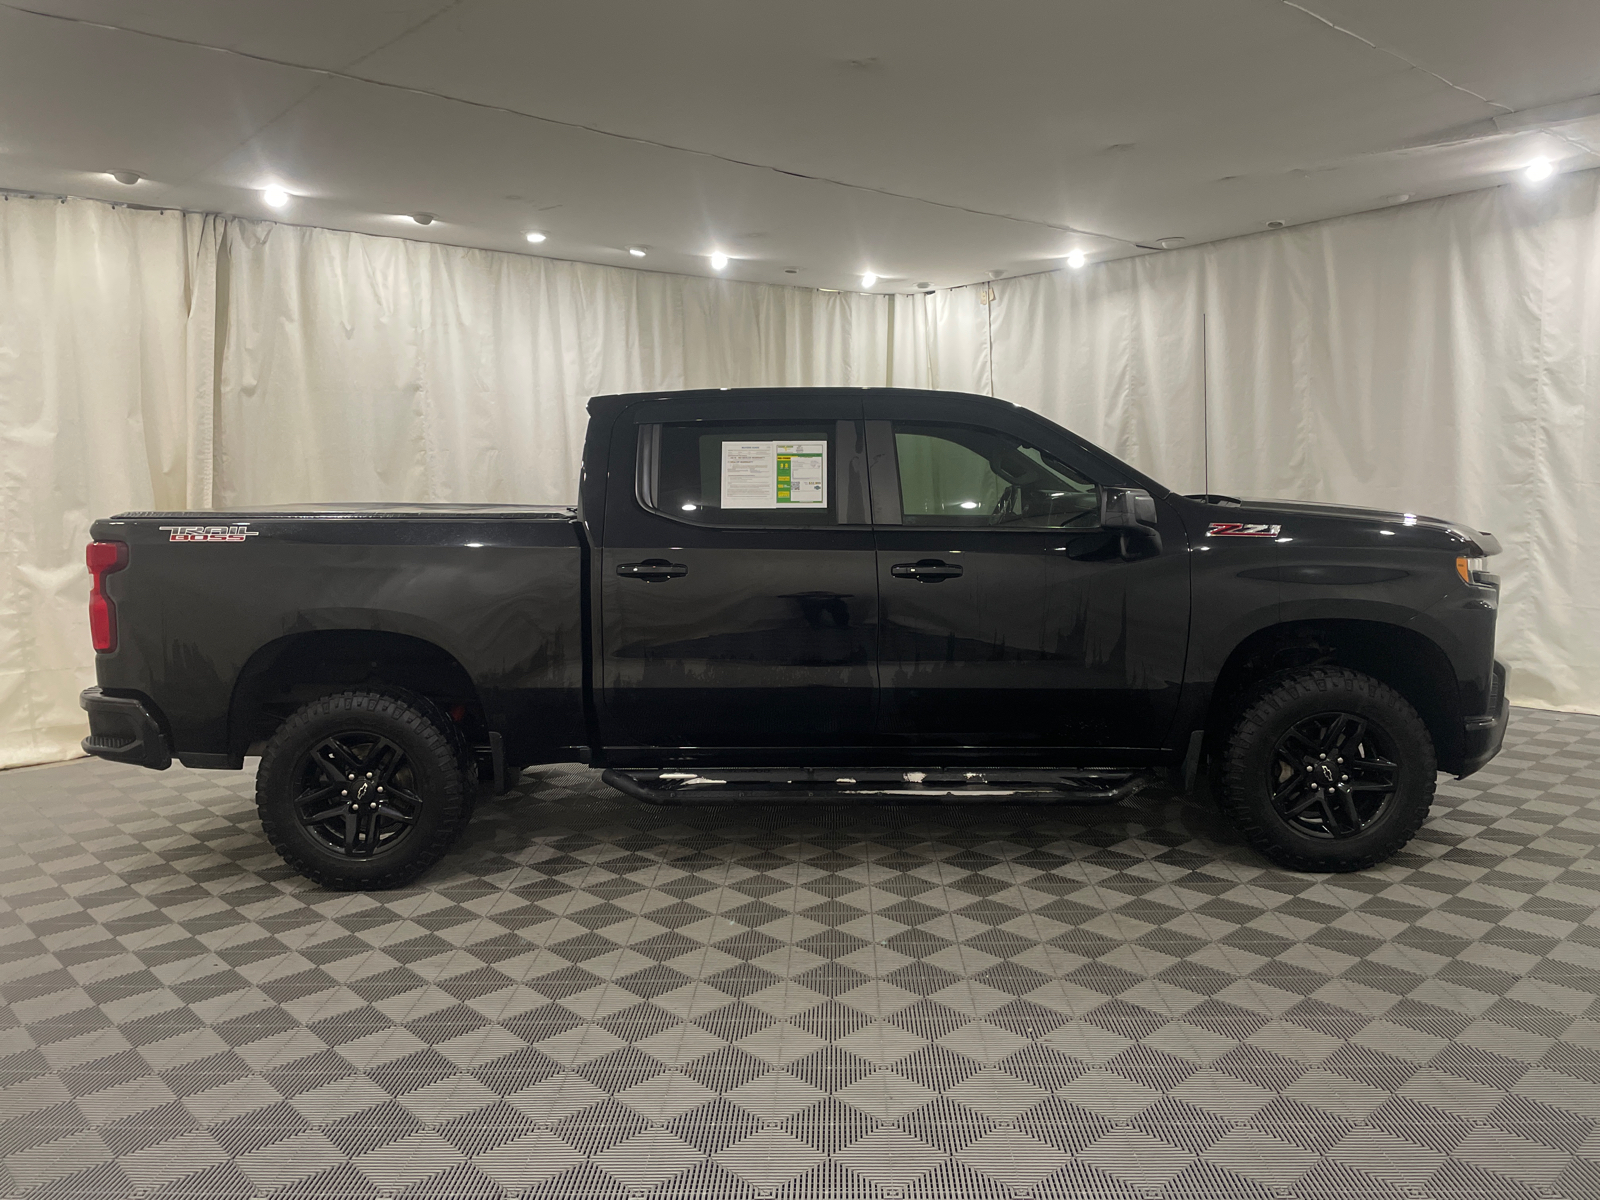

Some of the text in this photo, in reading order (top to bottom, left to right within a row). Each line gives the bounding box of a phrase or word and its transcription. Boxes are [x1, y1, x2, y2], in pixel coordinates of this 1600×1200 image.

[159, 525, 259, 536] TRAIL
[1205, 522, 1282, 537] Z71
[170, 534, 246, 542] BOSS
